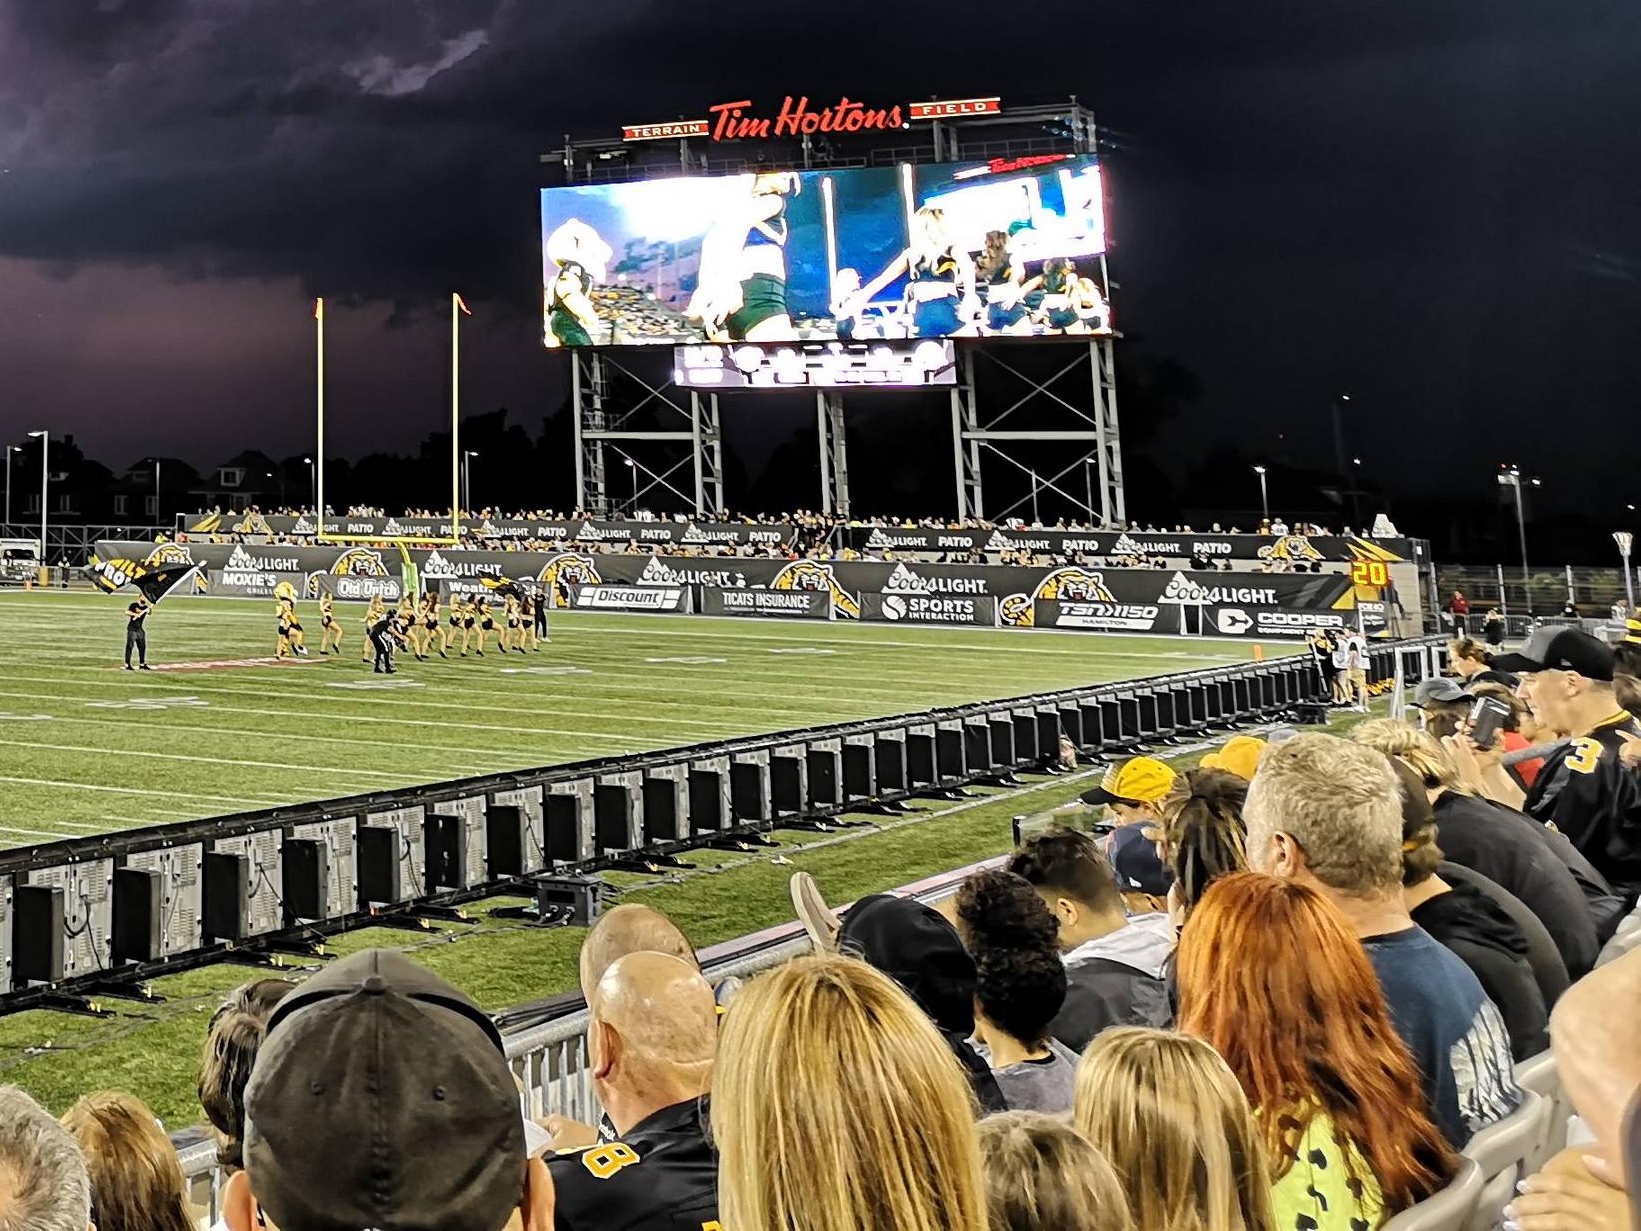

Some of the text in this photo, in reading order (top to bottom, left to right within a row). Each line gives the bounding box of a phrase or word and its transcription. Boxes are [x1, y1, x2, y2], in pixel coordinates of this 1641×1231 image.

[632, 96, 988, 142] TERRAIN Tim Hortons FIELD
[348, 524, 374, 533] PATIO
[538, 527, 567, 537] PATIO
[640, 529, 672, 540] PATIO
[749, 532, 781, 542] PATIO
[938, 536, 973, 547] PATIO
[1062, 539, 1099, 551] PATIO
[1193, 542, 1232, 554] PATIO
[264, 558, 299, 571] LIGHT
[222, 573, 276, 587] MOXIE'S
[687, 570, 730, 584] LIGHT
[1353, 562, 1386, 585] 20
[938, 578, 988, 593] LIGHT
[598, 590, 660, 603] Discount
[723, 592, 810, 608] TICATS INSURANCE
[1220, 588, 1278, 604] LIGHT
[909, 598, 974, 613] SPORTS
[909, 612, 974, 621] INTERACTION
[1257, 612, 1343, 627] COOPER
[1564, 736, 1604, 774] 3
[582, 1142, 641, 1179] 8
